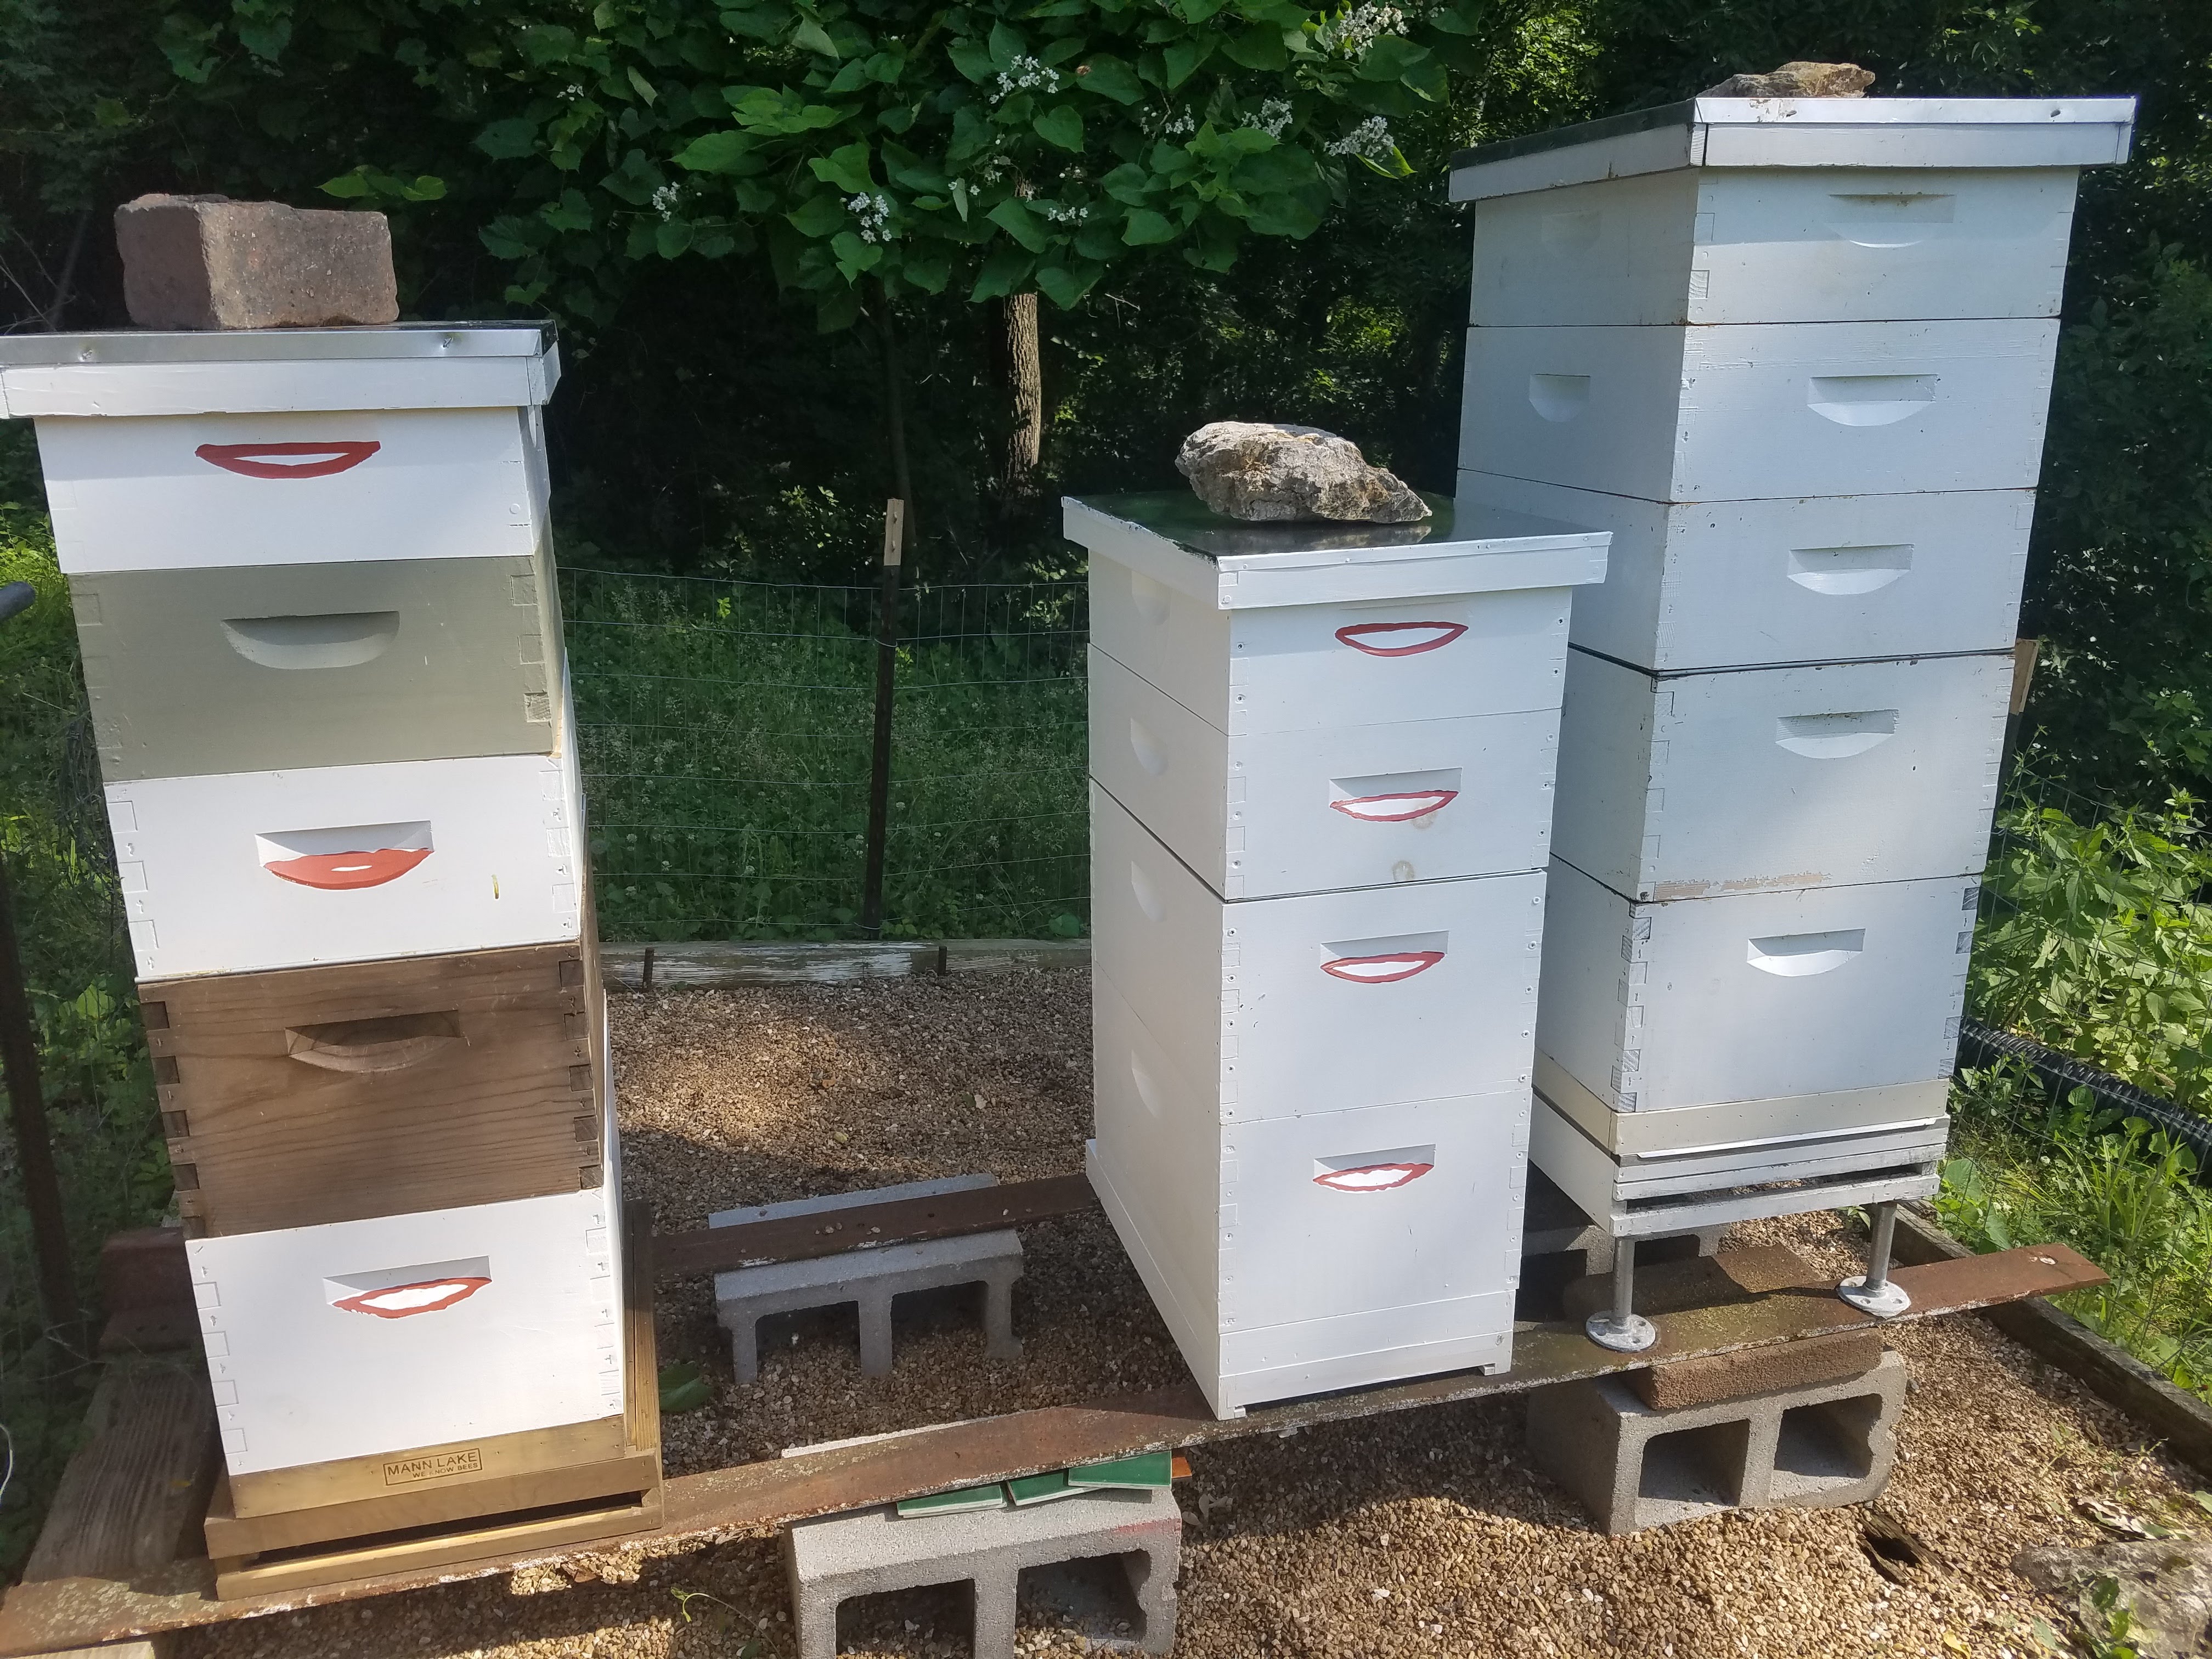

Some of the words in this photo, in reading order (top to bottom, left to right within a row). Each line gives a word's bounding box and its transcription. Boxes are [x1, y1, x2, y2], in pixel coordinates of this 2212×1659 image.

[387, 1460, 432, 1476] MANN
[437, 1452, 477, 1468] LAKE
[457, 1463, 478, 1471] BEES
